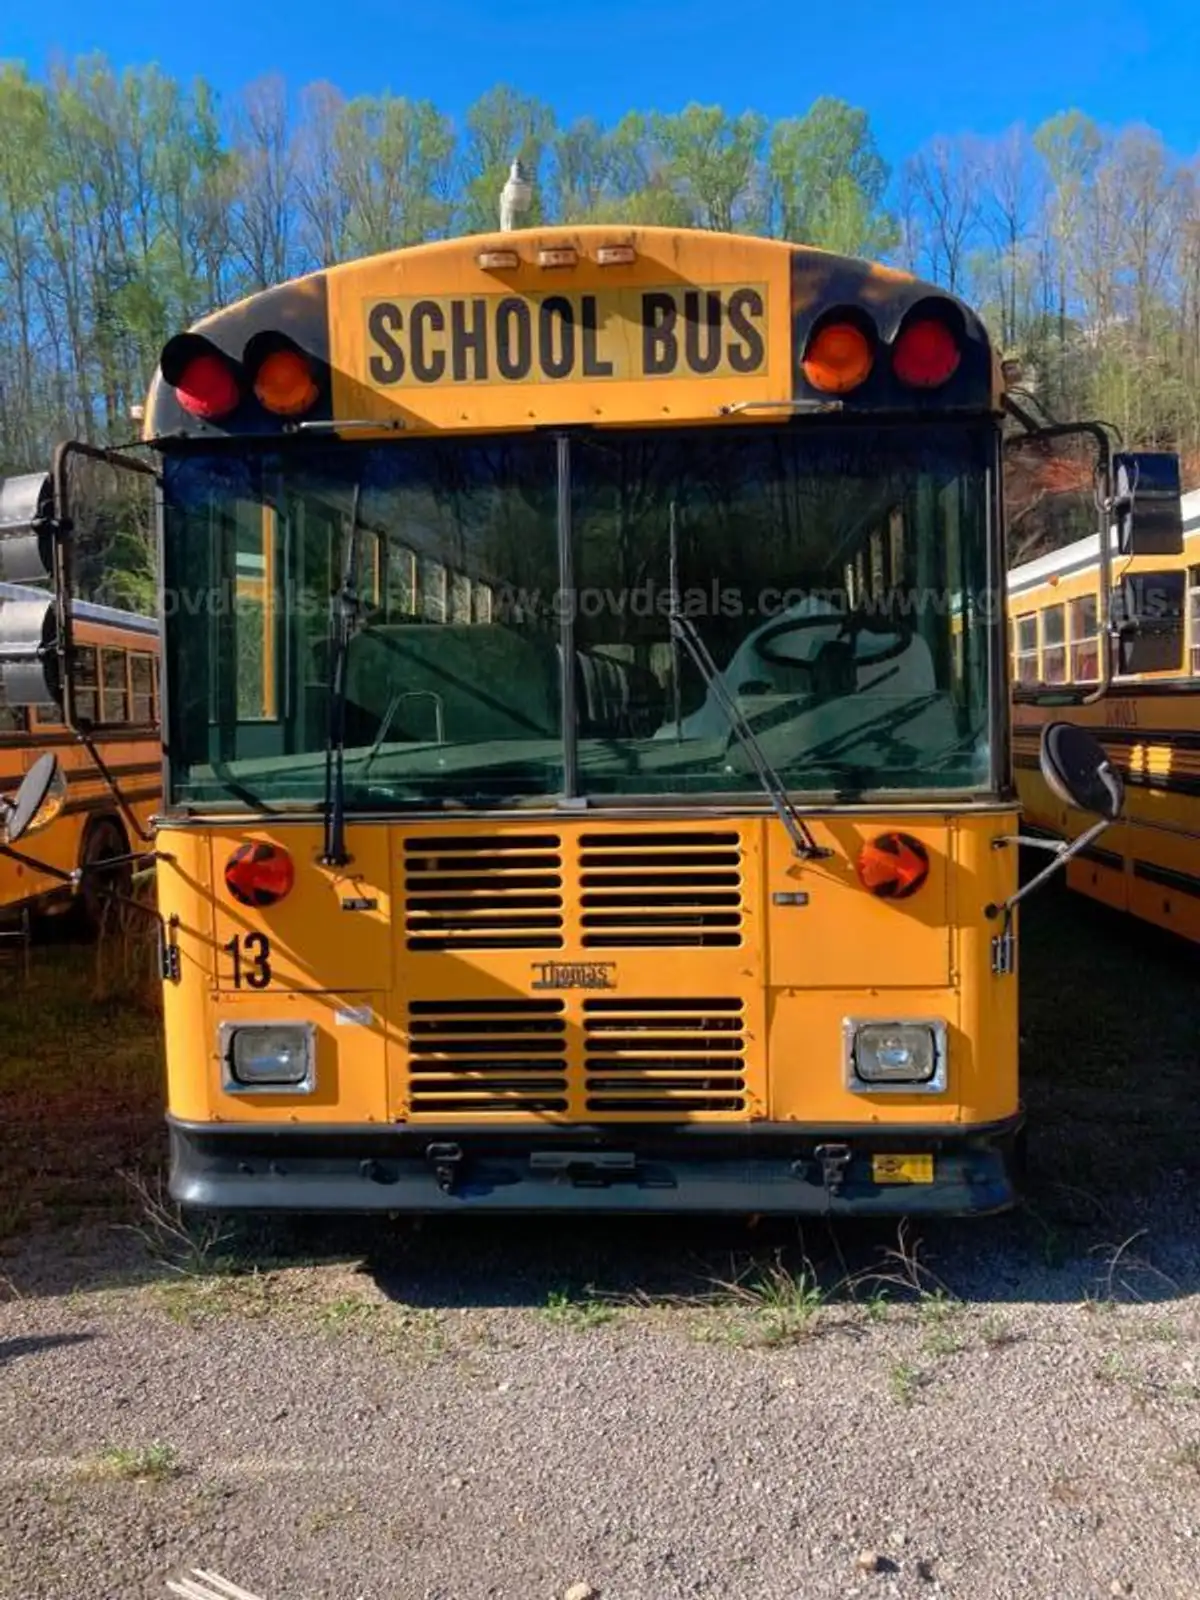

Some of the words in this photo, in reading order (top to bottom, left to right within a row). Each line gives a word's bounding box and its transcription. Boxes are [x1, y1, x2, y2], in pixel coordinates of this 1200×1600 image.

[368, 294, 614, 385] SCHOOL
[641, 288, 766, 376] BUS
[223, 931, 272, 989] 13
[536, 960, 612, 986] Thomas
